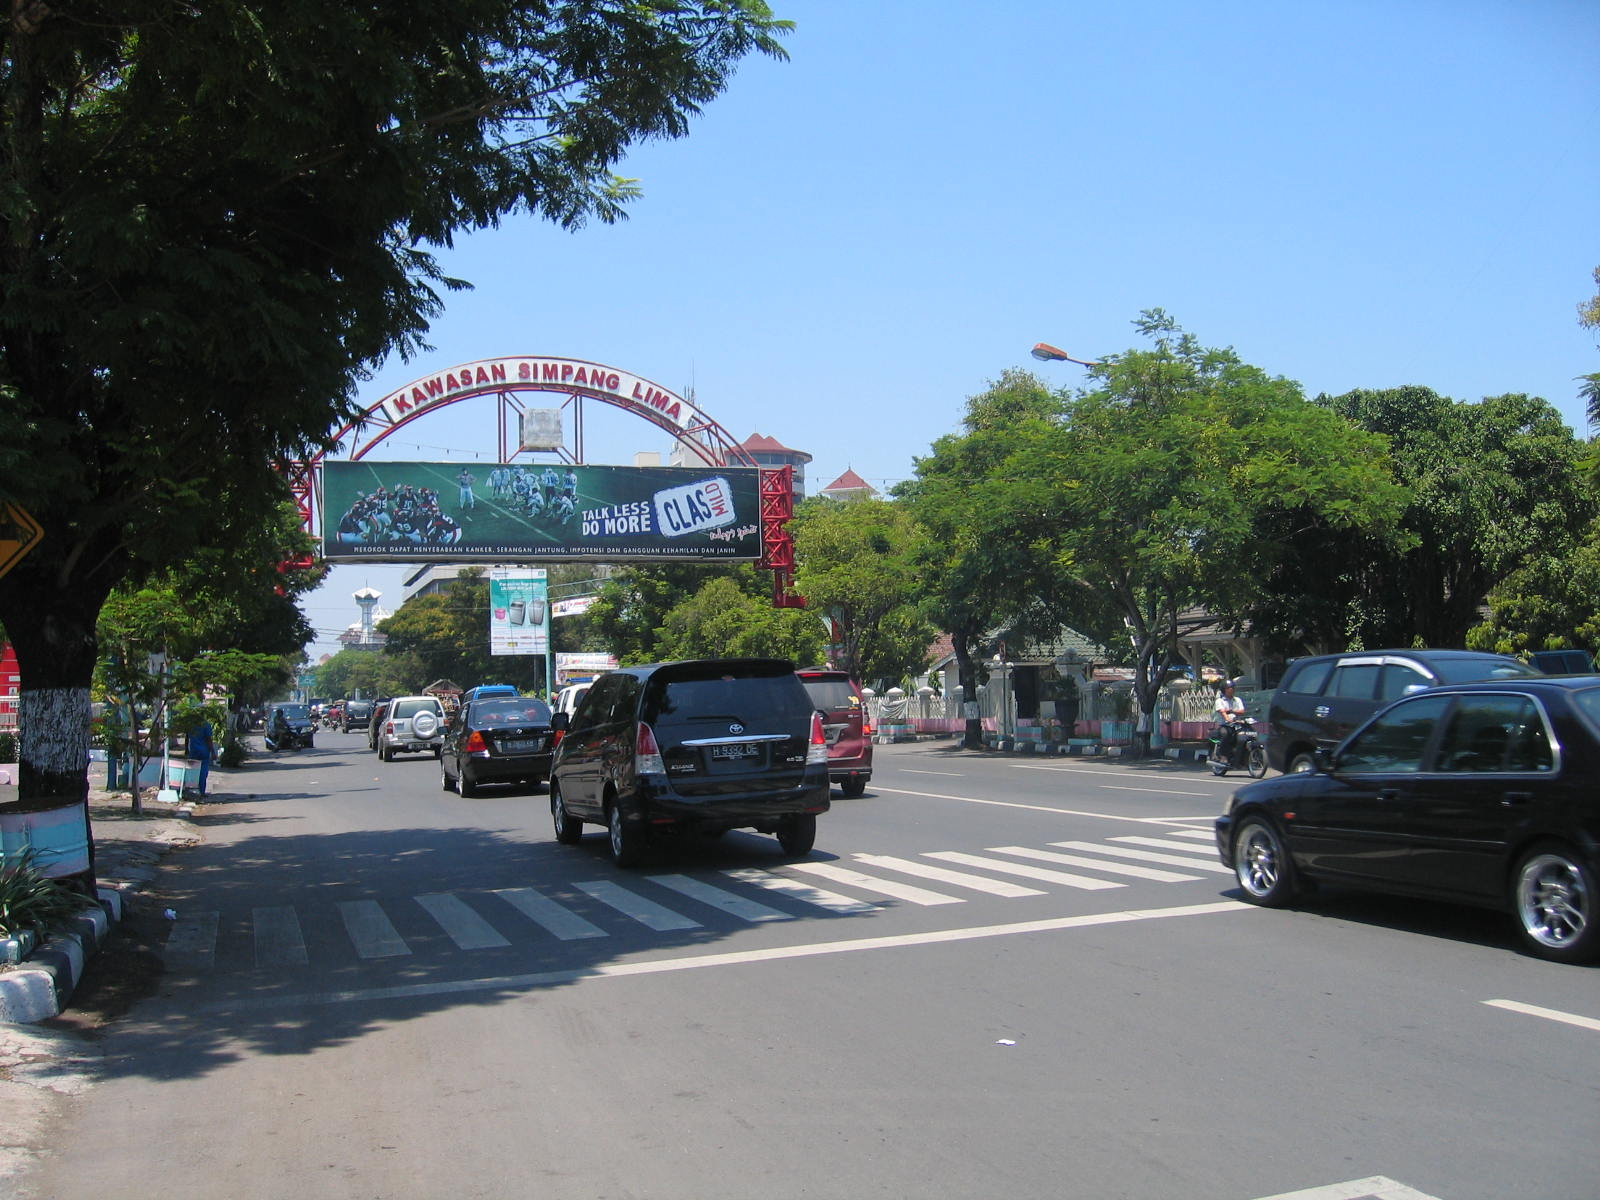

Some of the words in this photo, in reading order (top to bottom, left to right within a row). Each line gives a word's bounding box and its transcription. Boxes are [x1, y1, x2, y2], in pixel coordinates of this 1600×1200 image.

[392, 362, 507, 414] KAWASAN
[517, 362, 620, 391] SIMPANG
[631, 381, 682, 420] LIMA
[663, 489, 713, 532] CLAS
[704, 482, 729, 517] MILD
[581, 507, 610, 522] TALK
[614, 500, 650, 518] LESS
[582, 520, 600, 536] DO
[604, 514, 651, 535] MORE
[716, 547, 736, 555] JANIN
[713, 746, 720, 756] H
